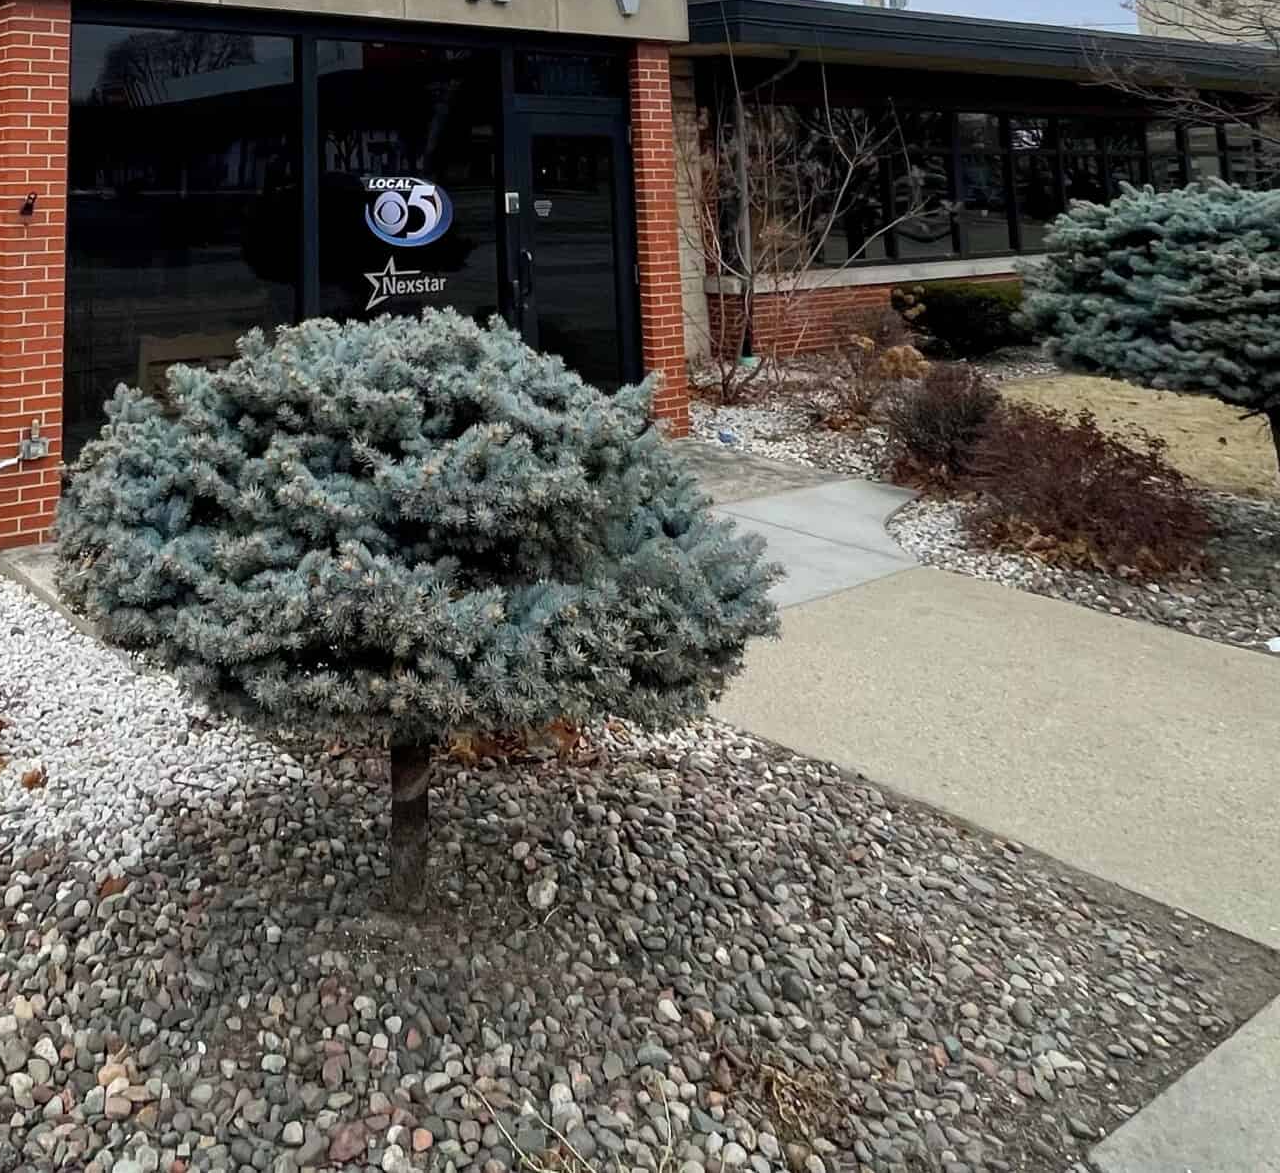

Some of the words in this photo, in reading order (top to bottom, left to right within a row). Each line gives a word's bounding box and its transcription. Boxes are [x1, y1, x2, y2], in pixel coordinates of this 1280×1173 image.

[368, 178, 413, 189] LOCAL
[406, 185, 437, 238] 5
[382, 276, 447, 295] Nexstar
